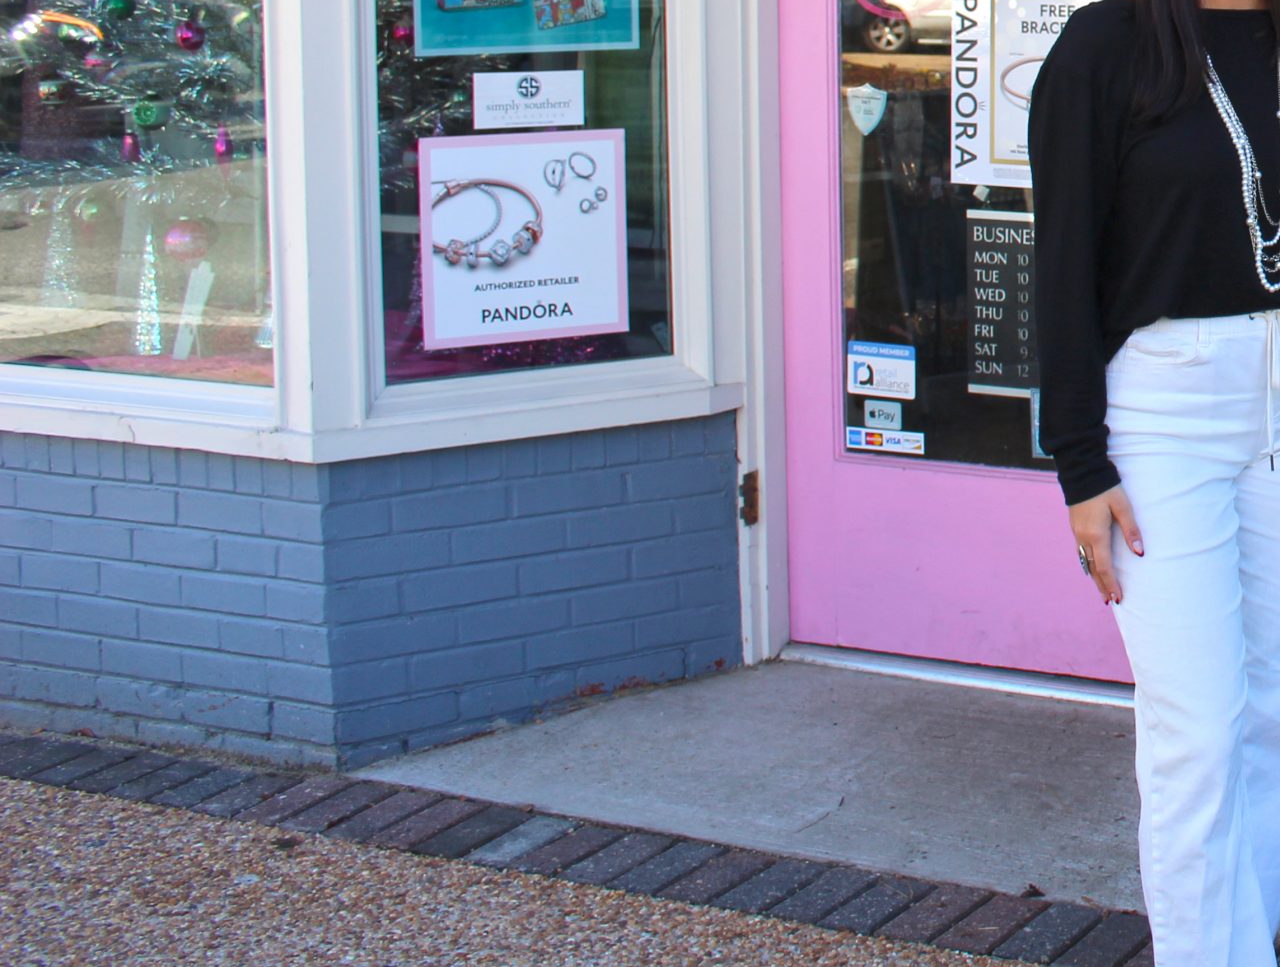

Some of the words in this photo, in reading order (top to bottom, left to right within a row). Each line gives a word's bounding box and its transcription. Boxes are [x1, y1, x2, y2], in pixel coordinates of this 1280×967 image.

[1040, 4, 1076, 18] FREE
[486, 99, 520, 114] simply
[524, 98, 570, 110] southern
[974, 251, 1007, 265] MON
[974, 269, 999, 283] TUE
[474, 280, 536, 292] AUTHORIZED
[537, 276, 579, 287] RETAILER
[974, 287, 1006, 302] WED
[482, 302, 573, 323] PANDORA
[974, 305, 1003, 320] THU
[974, 324, 994, 338] FRI
[853, 344, 878, 354] PROUD
[879, 346, 910, 357] MEMBER
[975, 342, 998, 356] SAT
[975, 360, 1003, 375] SUN
[875, 377, 911, 390] alliance
[877, 409, 896, 423] Pay
[885, 437, 901, 445] VISA
